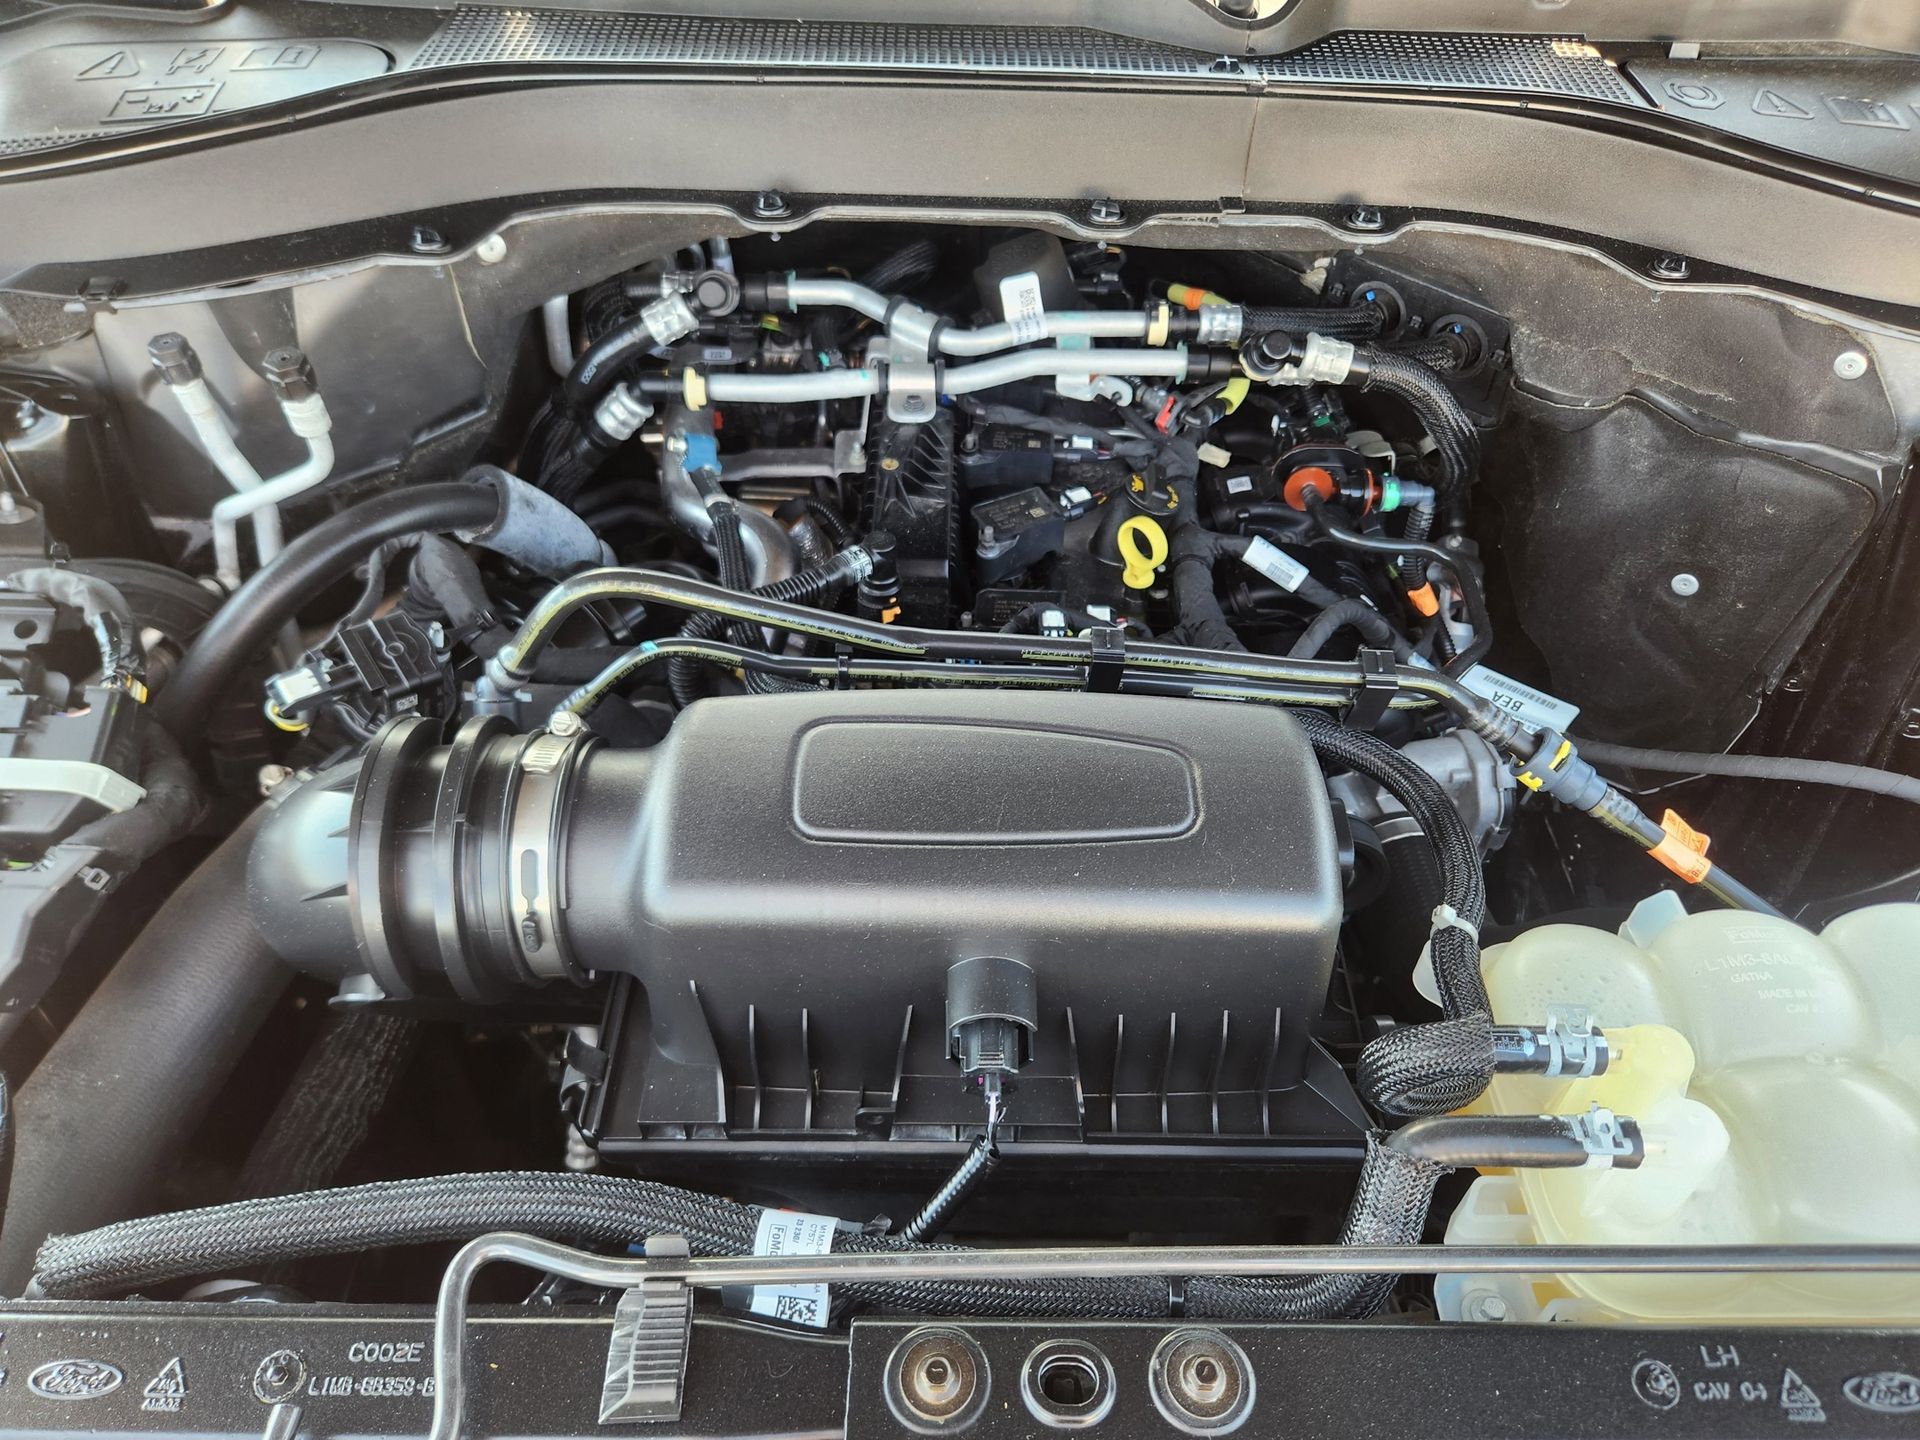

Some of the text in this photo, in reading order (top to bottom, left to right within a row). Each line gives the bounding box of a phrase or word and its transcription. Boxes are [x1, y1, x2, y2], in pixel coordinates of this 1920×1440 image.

[769, 1226, 785, 1255] FoMo
[1699, 1344, 1740, 1368] LH
[37, 1361, 116, 1397] Ford
[1693, 1381, 1730, 1402] CAV
